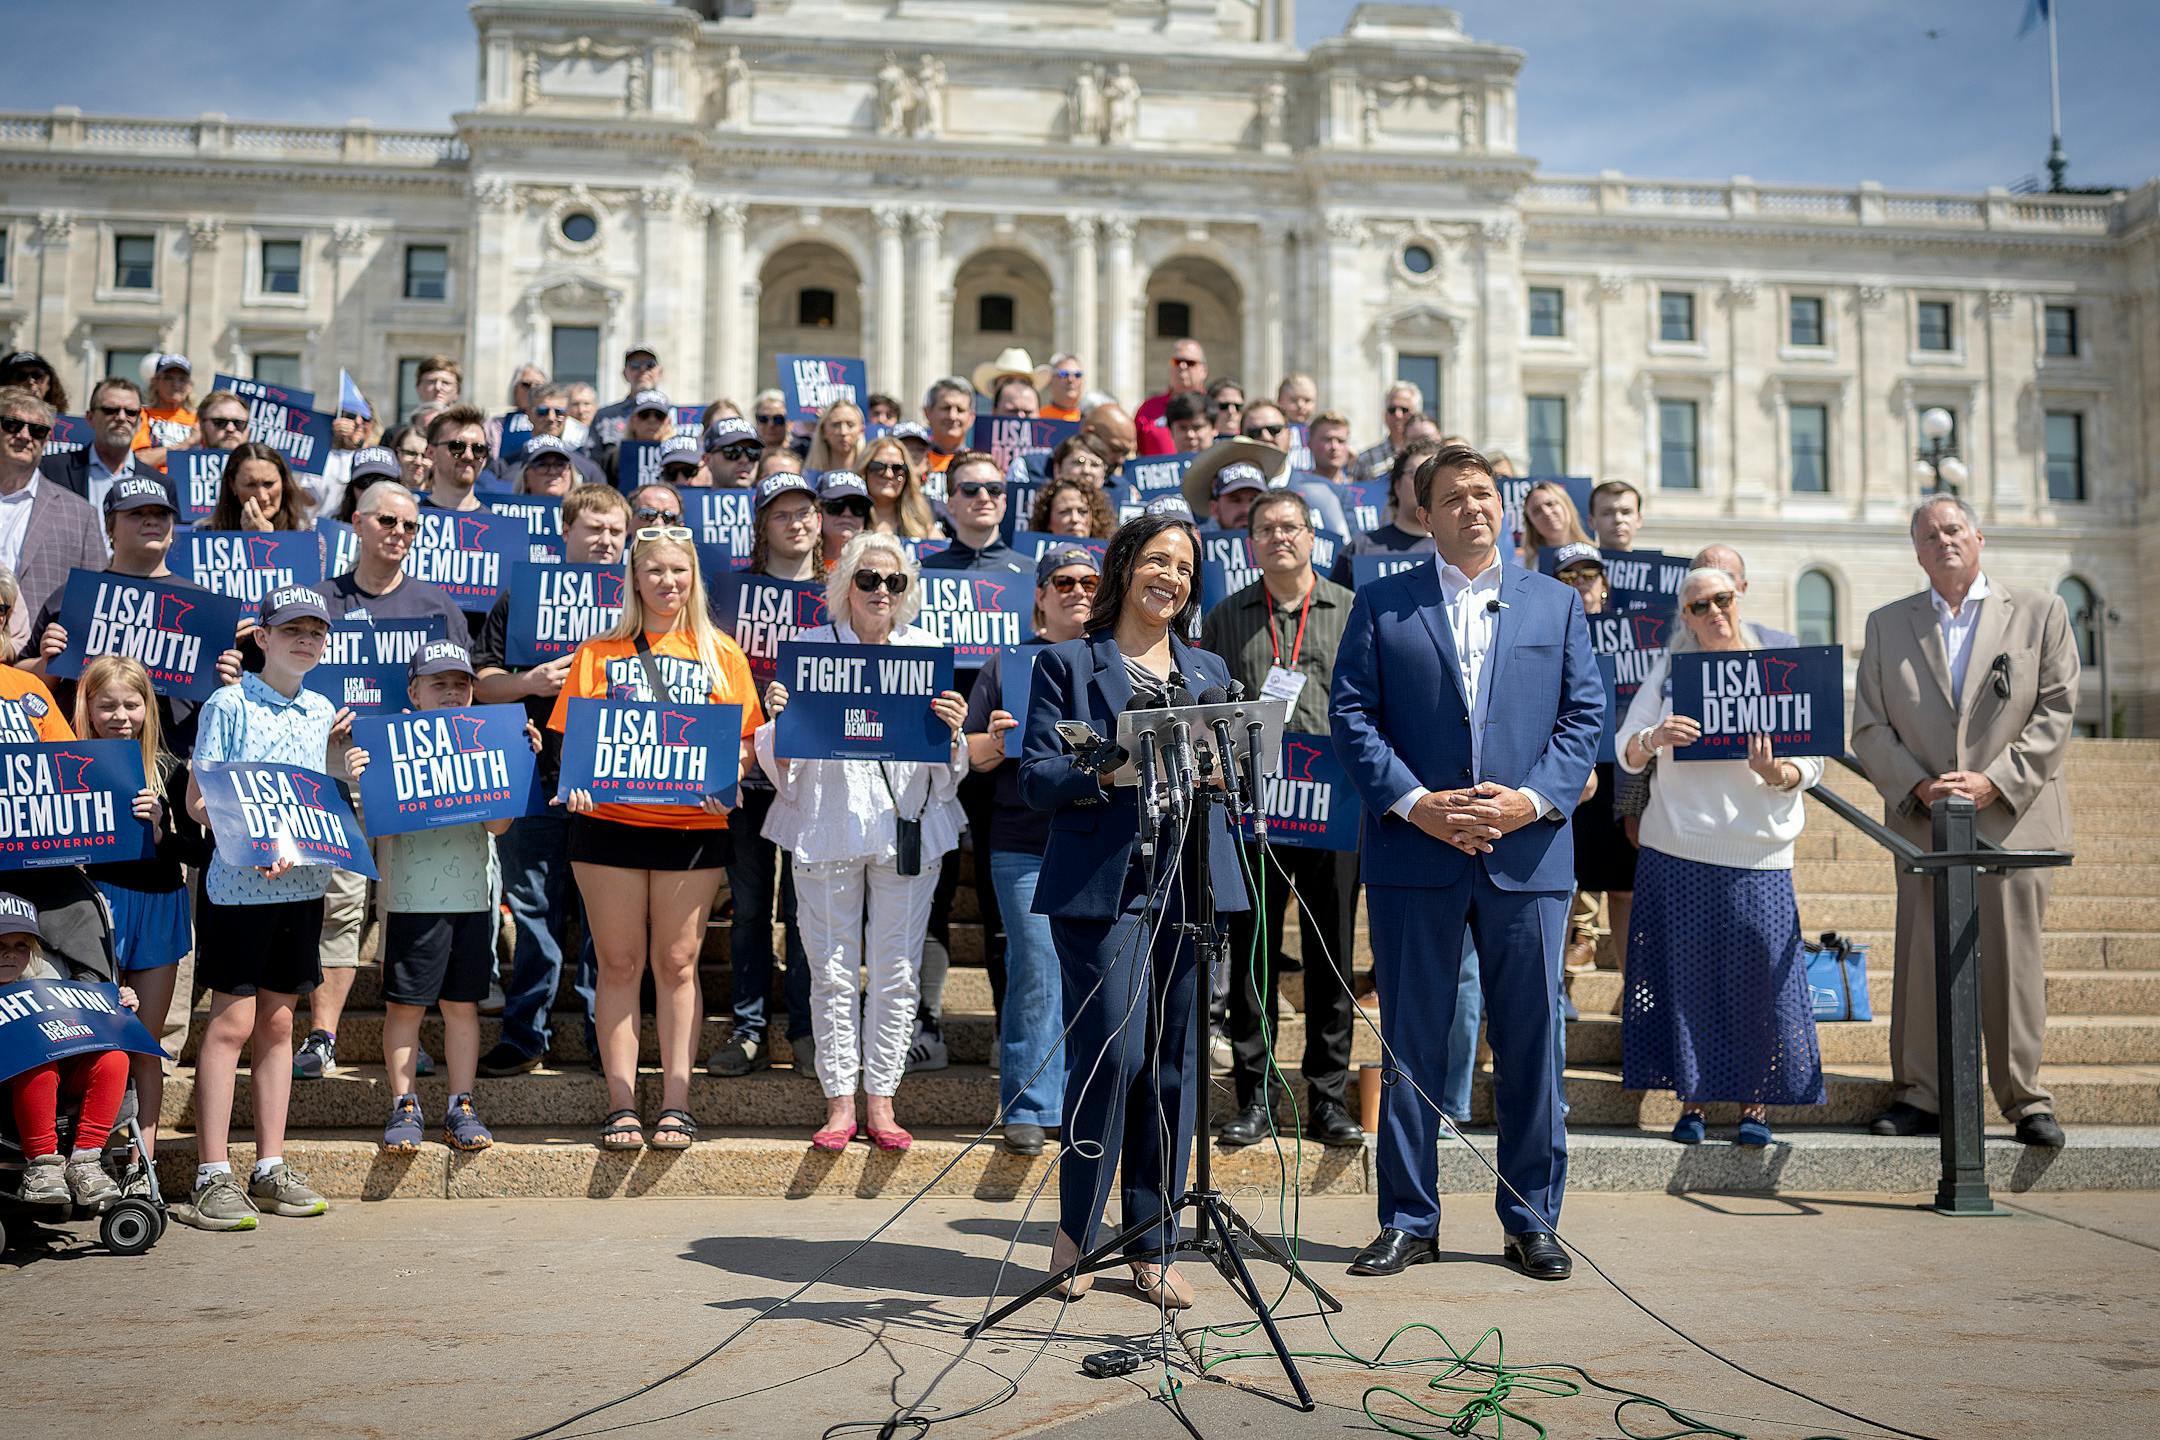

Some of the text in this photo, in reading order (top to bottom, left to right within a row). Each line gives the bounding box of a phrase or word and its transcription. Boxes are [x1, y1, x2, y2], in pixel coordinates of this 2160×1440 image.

[793, 359, 831, 384] LISA
[248, 399, 288, 433] LISA
[991, 419, 1033, 448] LISA
[120, 478, 168, 500] DEMUTH
[763, 472, 808, 496] DEMUTH
[701, 494, 754, 527] LISA
[411, 513, 456, 550] ISA
[192, 536, 248, 571] LISA
[1207, 538, 1247, 571] ISA
[93, 582, 155, 628] LISA
[273, 587, 326, 611] DEMUTH
[438, 584, 497, 596] OVERNOR
[539, 571, 594, 607] LISA
[738, 583, 794, 626] LISA
[919, 578, 976, 612] LISA
[536, 605, 623, 642] DEMUT
[736, 619, 810, 659] DEM
[920, 610, 1021, 646] DEMUTH
[1587, 617, 1635, 654] ISA
[85, 618, 201, 673] DEMUTH
[320, 632, 369, 665] GHT.
[424, 643, 470, 667] DEMUTH
[536, 643, 560, 652] FOR
[344, 677, 366, 690] LISA
[611, 657, 709, 689] DEUTH
[796, 656, 935, 696] FIGHT. WIN!
[1702, 659, 1762, 698] LISA
[344, 688, 382, 704] DEMUTH
[597, 708, 658, 745] LISA
[844, 721, 884, 737] DEMUTH
[845, 708, 866, 723] LISA
[1703, 692, 1812, 734] DEMUTH
[387, 717, 454, 762] LISA
[1704, 733, 1812, 746] FOR GRNOR
[393, 749, 510, 801] DEMUTH
[593, 743, 708, 782] DEMUTH
[229, 770, 299, 805] LISA
[398, 790, 511, 813] FOR GOVERNOR
[592, 780, 704, 792] FOR GOVERNOR
[1262, 777, 1332, 822] MUTH
[31, 835, 116, 850] GOVERNOR
[241, 803, 349, 849] DEMUTH
[297, 841, 353, 860] OVERNOR
[0, 897, 36, 923] MUTH
[46, 986, 117, 1016] WIN!
[37, 1020, 68, 1033] LISA
[46, 1024, 94, 1041] DEMUTH
